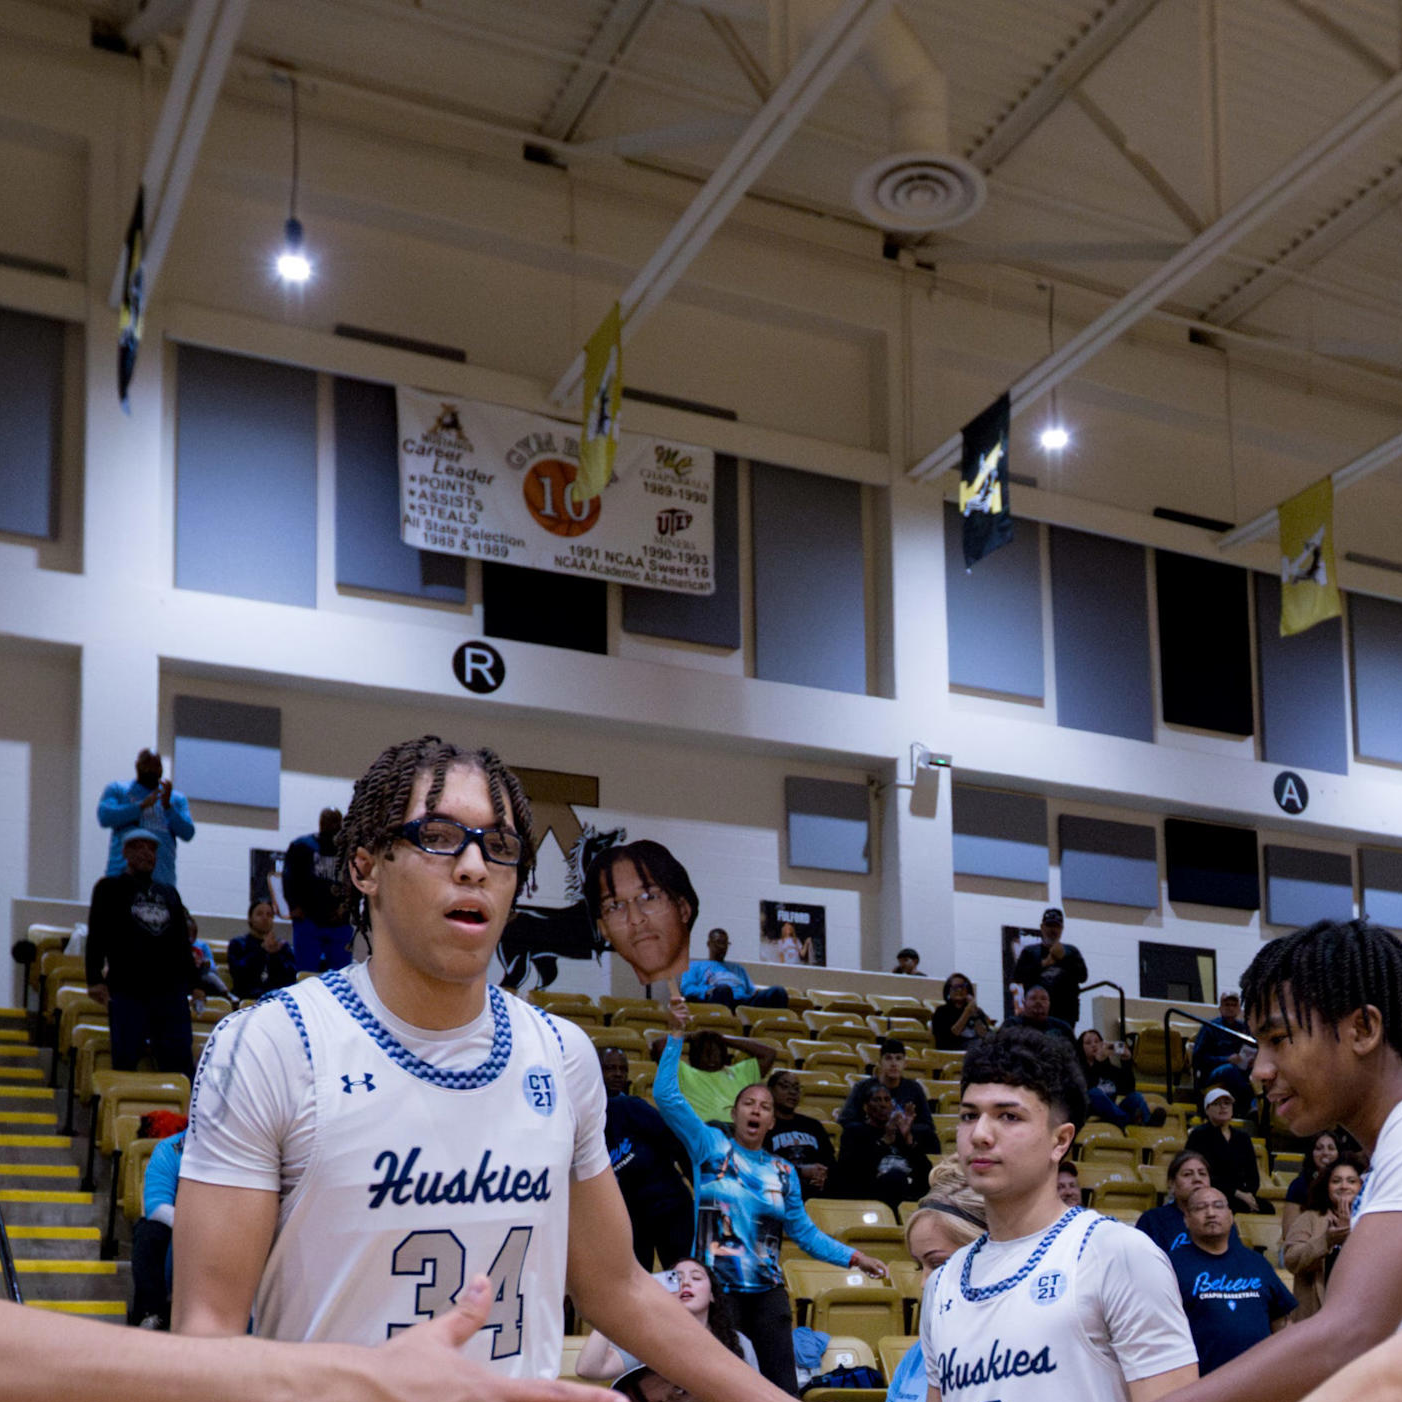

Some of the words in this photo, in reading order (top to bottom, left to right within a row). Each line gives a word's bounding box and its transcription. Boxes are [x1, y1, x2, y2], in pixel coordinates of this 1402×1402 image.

[403, 439, 462, 462] Career
[506, 433, 557, 471] GYM
[433, 459, 495, 485] Leader
[643, 481, 708, 504] 1989-1990
[403, 514, 420, 528] All
[424, 520, 459, 535] State
[463, 527, 526, 547] Selection
[656, 508, 694, 537] UTEP
[423, 532, 455, 547] 1988
[477, 543, 509, 558] 1989
[642, 545, 708, 566] 1990-1993
[554, 555, 586, 571] NCAA
[590, 560, 640, 580] Academic
[644, 571, 711, 592] All-American
[569, 545, 599, 560] 1991
[604, 551, 644, 568] NCAA
[649, 559, 689, 576] Sweet
[694, 566, 709, 579] 16
[464, 647, 496, 687] R
[1280, 777, 1303, 810] A
[528, 1074, 553, 1091] CT
[533, 1091, 553, 1108] 21
[368, 1147, 552, 1210] Huskies
[386, 1225, 534, 1361] 34
[1037, 1273, 1061, 1287] CT
[1037, 1287, 1057, 1300] 21
[1192, 1271, 1263, 1297] Believe
[938, 1339, 1058, 1396] Huskies
